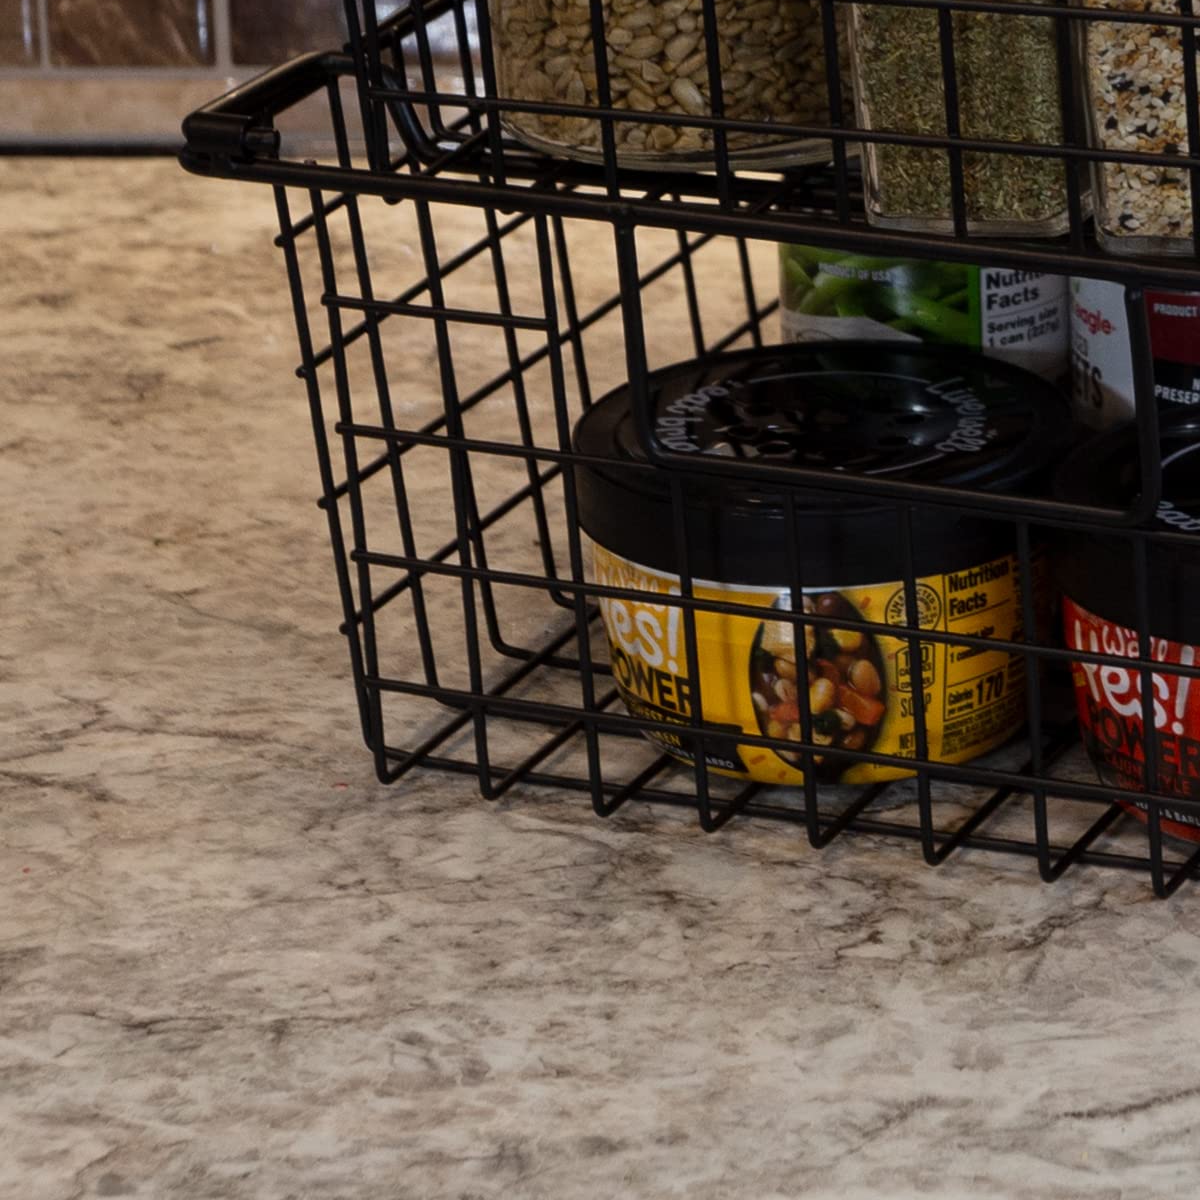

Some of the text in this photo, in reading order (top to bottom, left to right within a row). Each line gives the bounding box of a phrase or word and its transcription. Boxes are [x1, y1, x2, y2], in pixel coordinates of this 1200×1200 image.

[986, 286, 1039, 310] Facts
[1153, 302, 1197, 317] PRODUCT
[987, 314, 1036, 334] Serving
[1000, 332, 1024, 346] can
[925, 376, 987, 416] Live
[949, 559, 1010, 593] Nutrition
[949, 592, 987, 617] Facts
[976, 671, 1003, 705] 170
[1074, 619, 1195, 736] Yes!
[900, 692, 932, 718] SOP
